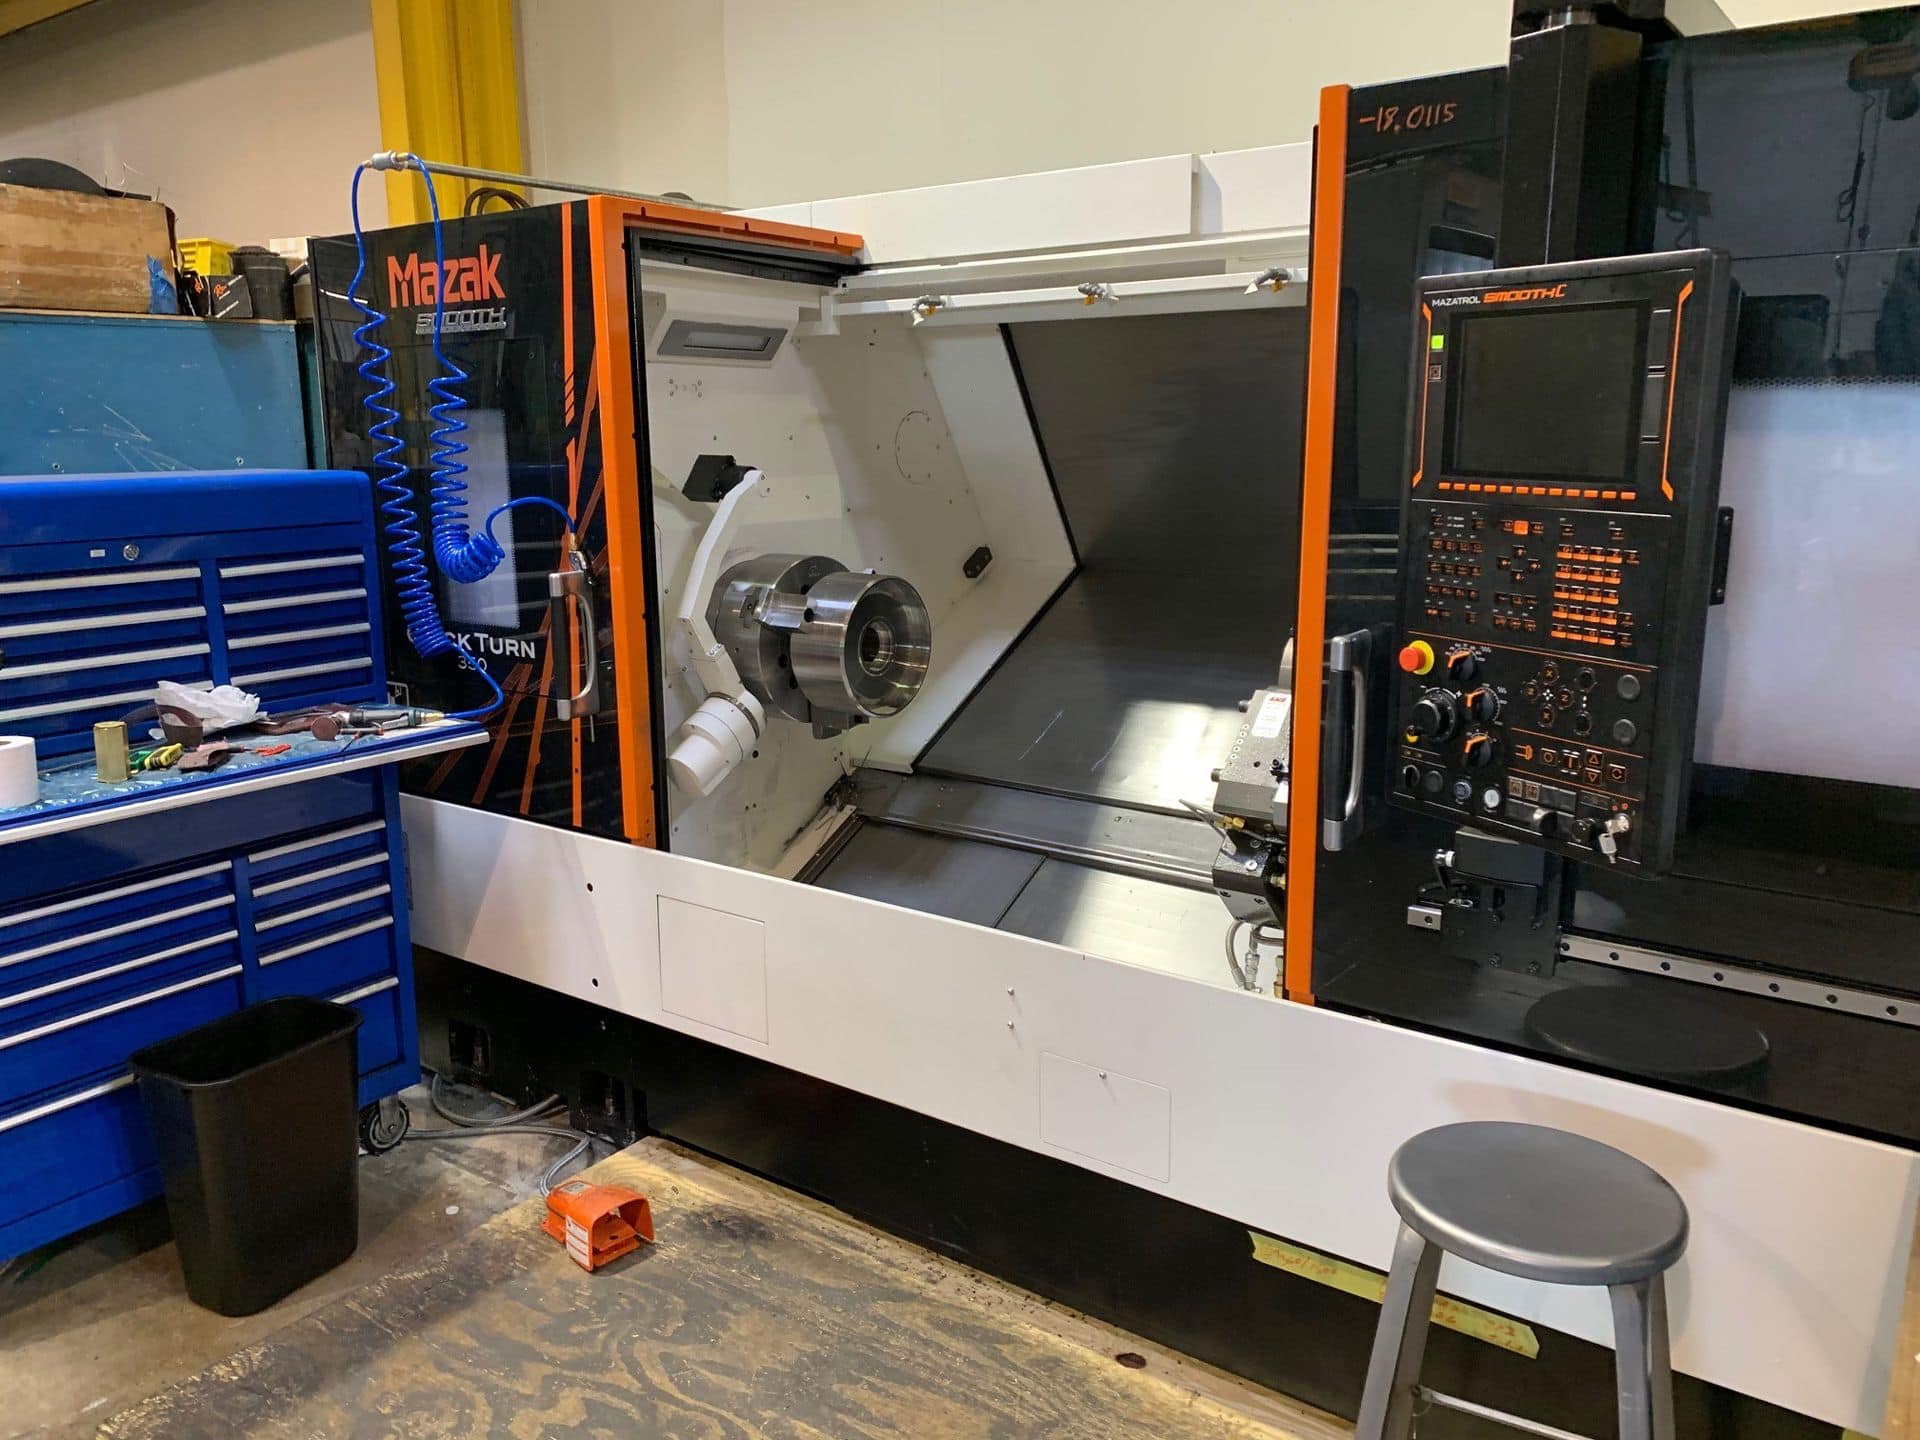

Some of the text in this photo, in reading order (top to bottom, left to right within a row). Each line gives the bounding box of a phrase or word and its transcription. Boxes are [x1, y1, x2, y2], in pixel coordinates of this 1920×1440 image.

[387, 244, 506, 308] Mazak
[1432, 295, 1481, 307] MAZATROL
[474, 632, 536, 659] TURN
